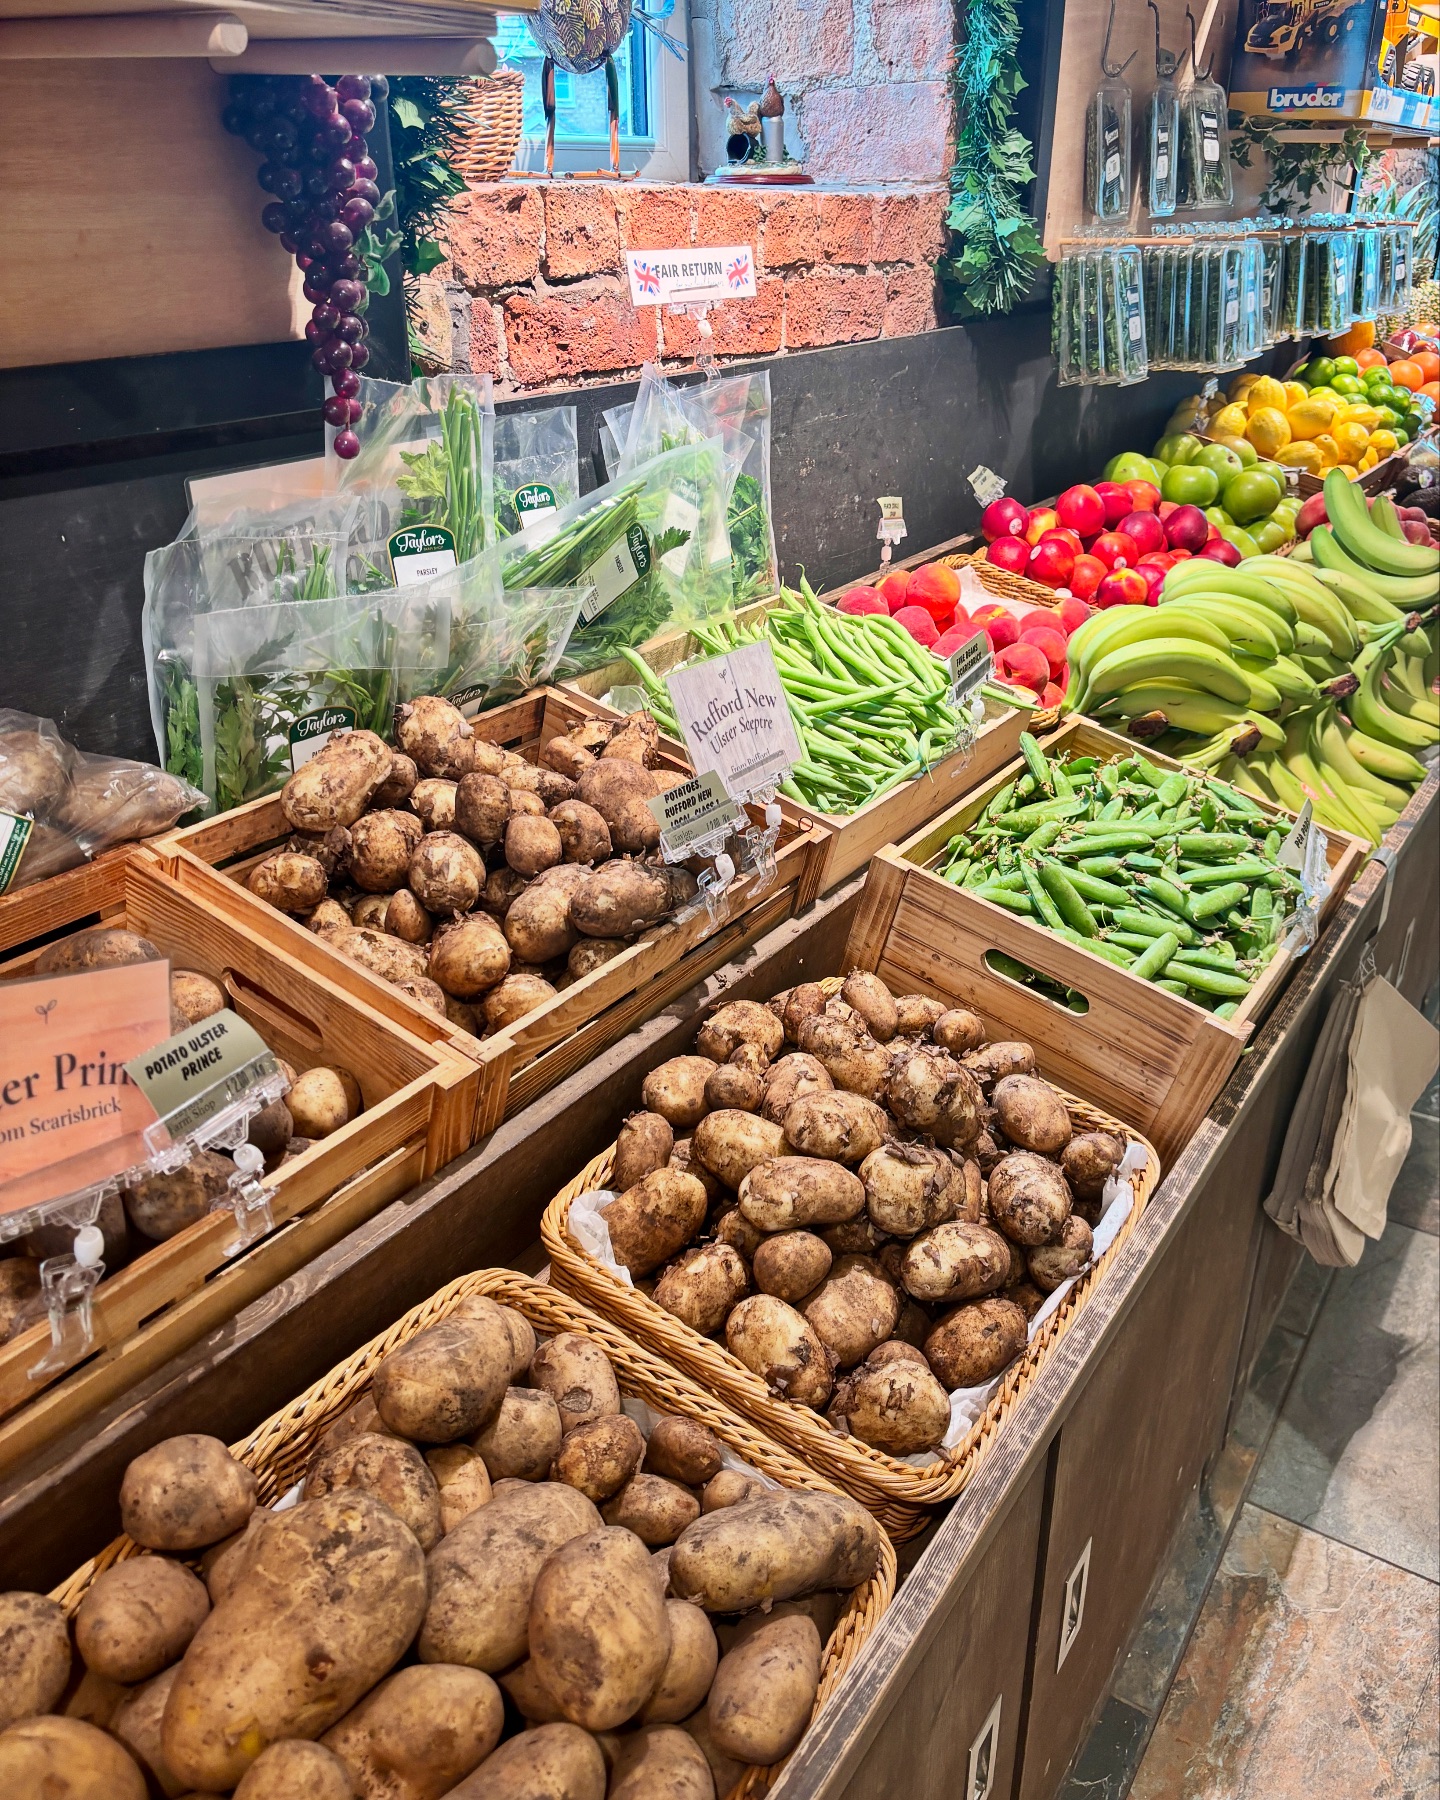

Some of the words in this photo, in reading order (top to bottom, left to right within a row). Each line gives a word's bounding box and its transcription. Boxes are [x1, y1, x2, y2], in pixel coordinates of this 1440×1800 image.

[1269, 88, 1342, 107] bruder
[655, 264, 679, 279] FAIR
[682, 261, 723, 277] RETURN
[519, 487, 551, 508] Taylors
[396, 530, 446, 552] Taylors
[630, 526, 647, 568] Taylors
[417, 567, 438, 577] PARSLEY
[614, 554, 625, 574] PARSLEY
[965, 643, 979, 660] BEANS
[448, 688, 481, 707] Taylors
[297, 710, 347, 737] Taylors
[690, 688, 744, 743] Rufford
[744, 688, 777, 708] New
[710, 725, 737, 754] Ulster
[738, 716, 773, 735] Sceptre
[664, 780, 702, 804] POTATOES,
[664, 795, 697, 819] RUFFORD
[697, 787, 712, 802] NEW
[673, 830, 693, 842] Taylors
[1294, 833, 1305, 848] PEA
[1301, 817, 1310, 837] PODS
[145, 1045, 189, 1080] POTATO
[188, 1022, 229, 1053] ULSTER
[181, 1046, 223, 1081] PRINCE
[0, 1073, 40, 1110] er
[53, 1050, 138, 1092] Prin
[0, 1126, 25, 1143] om
[30, 1096, 122, 1135] Scarisbrick
[167, 1113, 193, 1136] Farm
[193, 1100, 216, 1119] Shop
